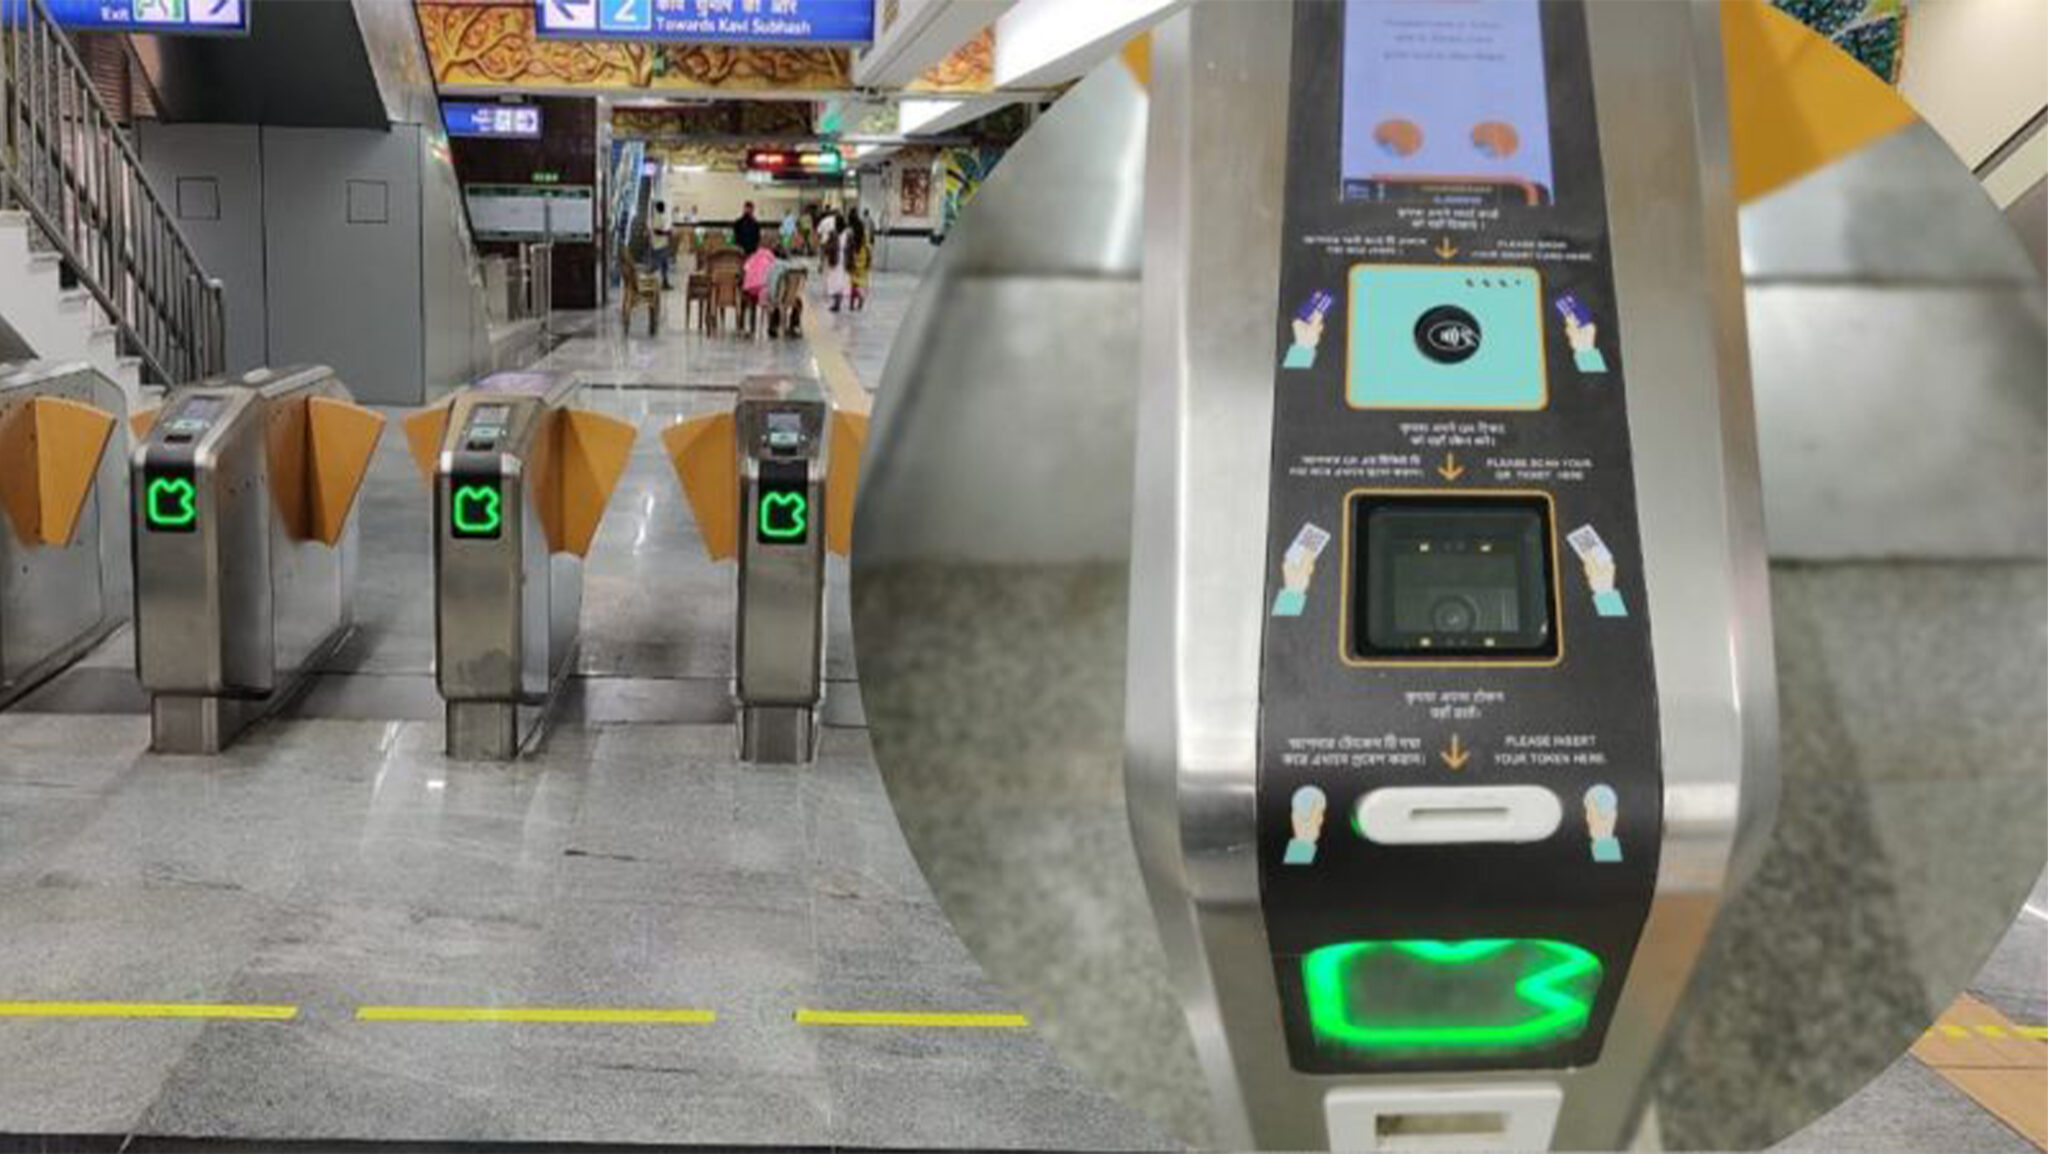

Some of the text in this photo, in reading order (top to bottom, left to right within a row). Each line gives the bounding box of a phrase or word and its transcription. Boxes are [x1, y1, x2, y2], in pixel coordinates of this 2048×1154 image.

[101, 7, 130, 21] Exit
[656, 17, 811, 35] Towards Kavi Subhash
[1486, 457, 1527, 468] PLEASE
[1562, 457, 1593, 468] YOUR
[1516, 470, 1552, 481] TICKET
[1504, 734, 1596, 748] PLEASE INSERT
[1494, 752, 1527, 766] YOUR
[1529, 752, 1571, 766] TOKEN
